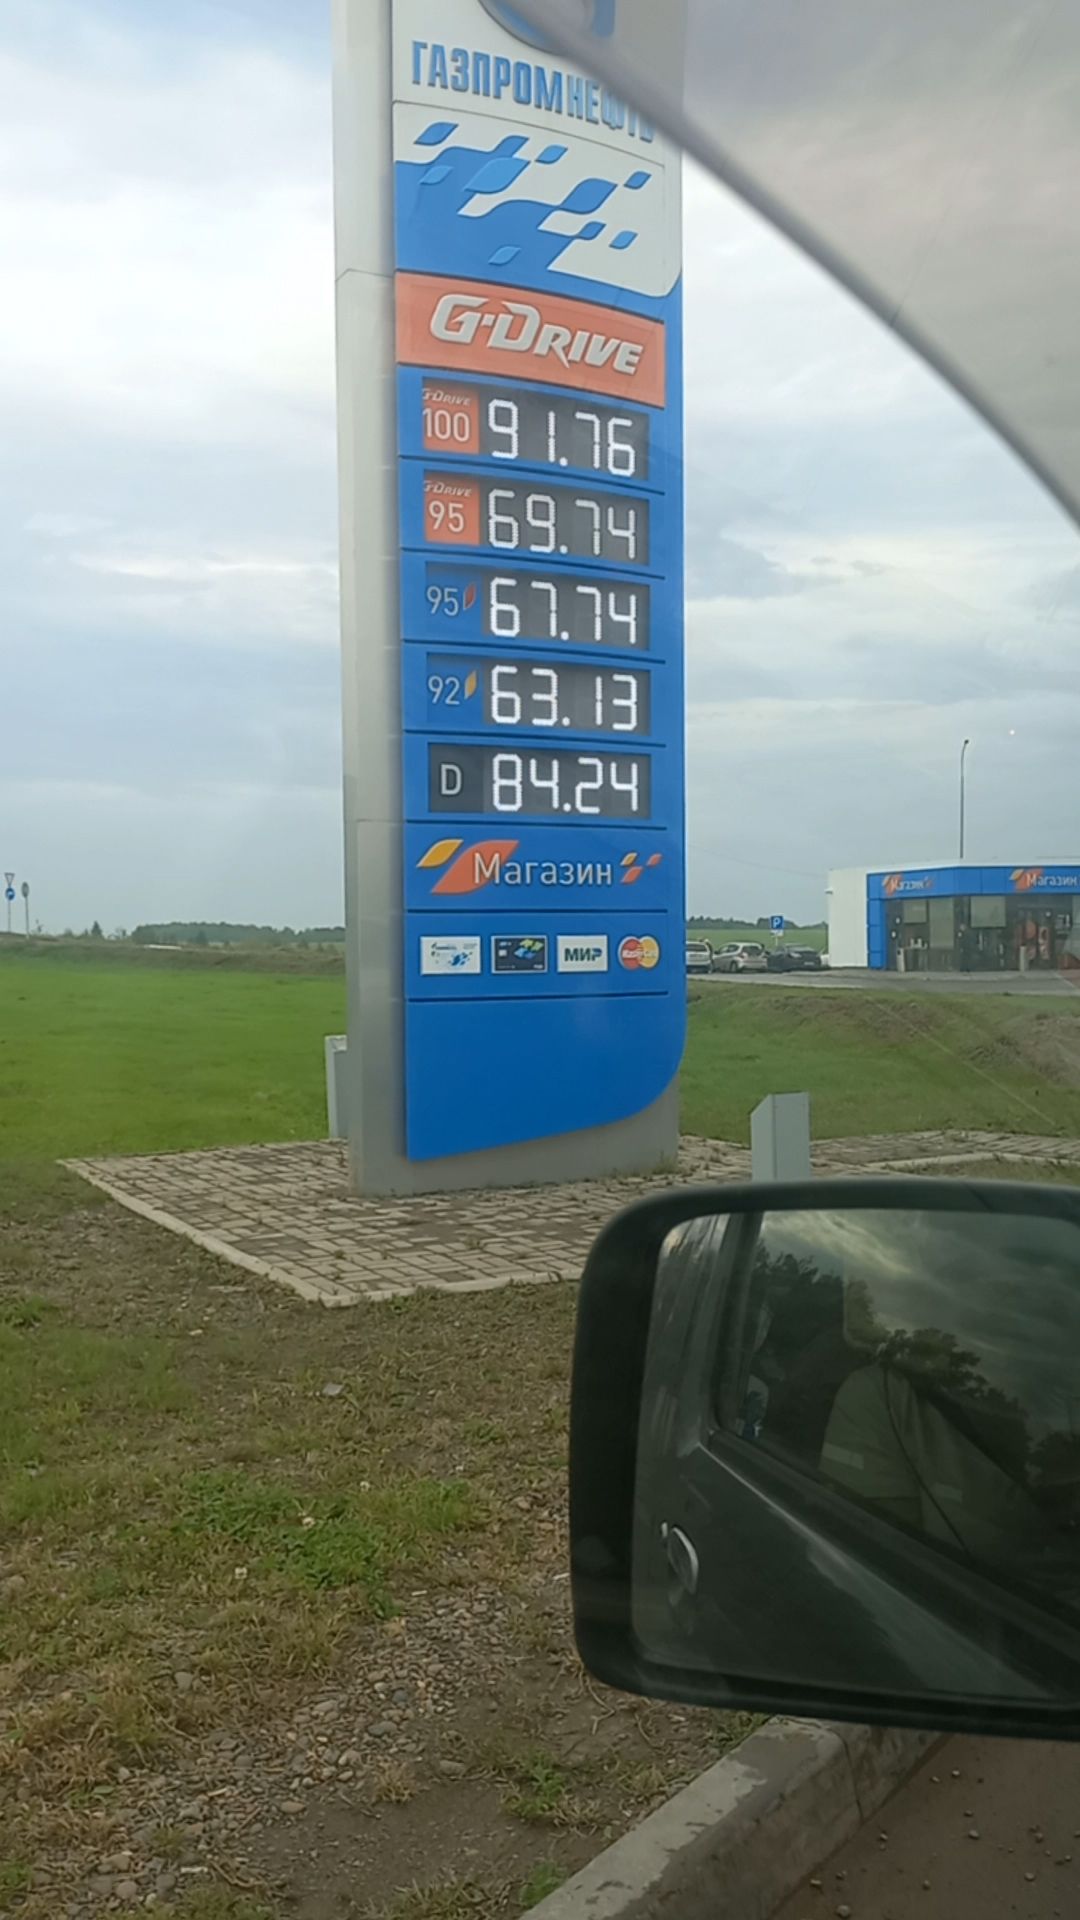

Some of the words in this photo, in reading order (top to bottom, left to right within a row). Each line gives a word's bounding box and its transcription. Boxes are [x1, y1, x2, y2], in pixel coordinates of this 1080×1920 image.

[422, 408, 470, 442] 100
[488, 399, 636, 477] 91.76
[429, 500, 464, 532] 95
[488, 488, 637, 559] 69.74
[426, 585, 459, 616] 95
[490, 576, 637, 644] 67.74
[427, 675, 460, 705] 92
[491, 664, 638, 731] 63.13
[440, 763, 462, 796] D
[493, 753, 639, 814] 84.24
[473, 852, 612, 885] Магазин
[1026, 872, 1078, 888] Магазин
[564, 947, 602, 962] МИР
